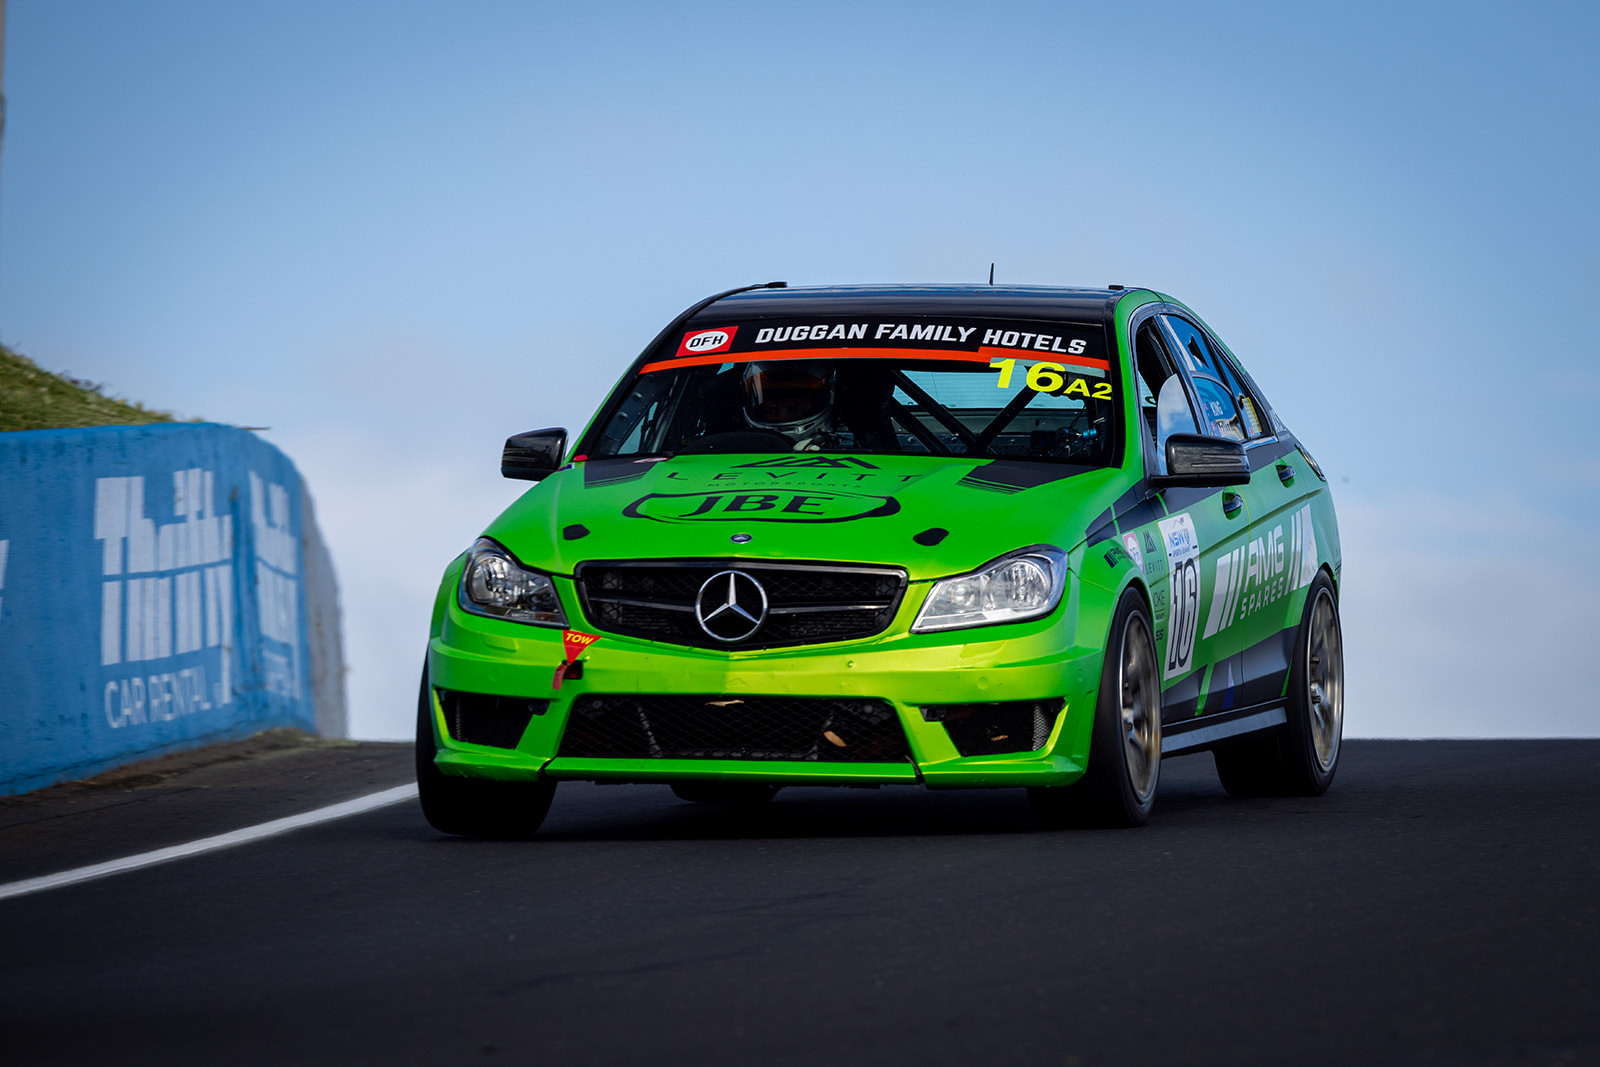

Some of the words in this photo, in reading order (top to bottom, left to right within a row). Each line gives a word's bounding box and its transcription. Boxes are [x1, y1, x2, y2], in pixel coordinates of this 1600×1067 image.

[689, 335, 724, 348] DFH
[755, 324, 868, 343] DUGGAN
[874, 324, 977, 342] FAMILY
[982, 329, 1087, 354] HOTELS
[989, 358, 1066, 393] 16
[1063, 378, 1113, 400] A2
[666, 471, 922, 482] LEVITT
[679, 494, 835, 515] JBE
[1244, 524, 1285, 593] AMG
[1168, 557, 1197, 671] 16
[1240, 576, 1284, 620] SPARES
[566, 633, 594, 645] TOW
[104, 677, 148, 728] CAR
[148, 665, 212, 722] RENTAL
